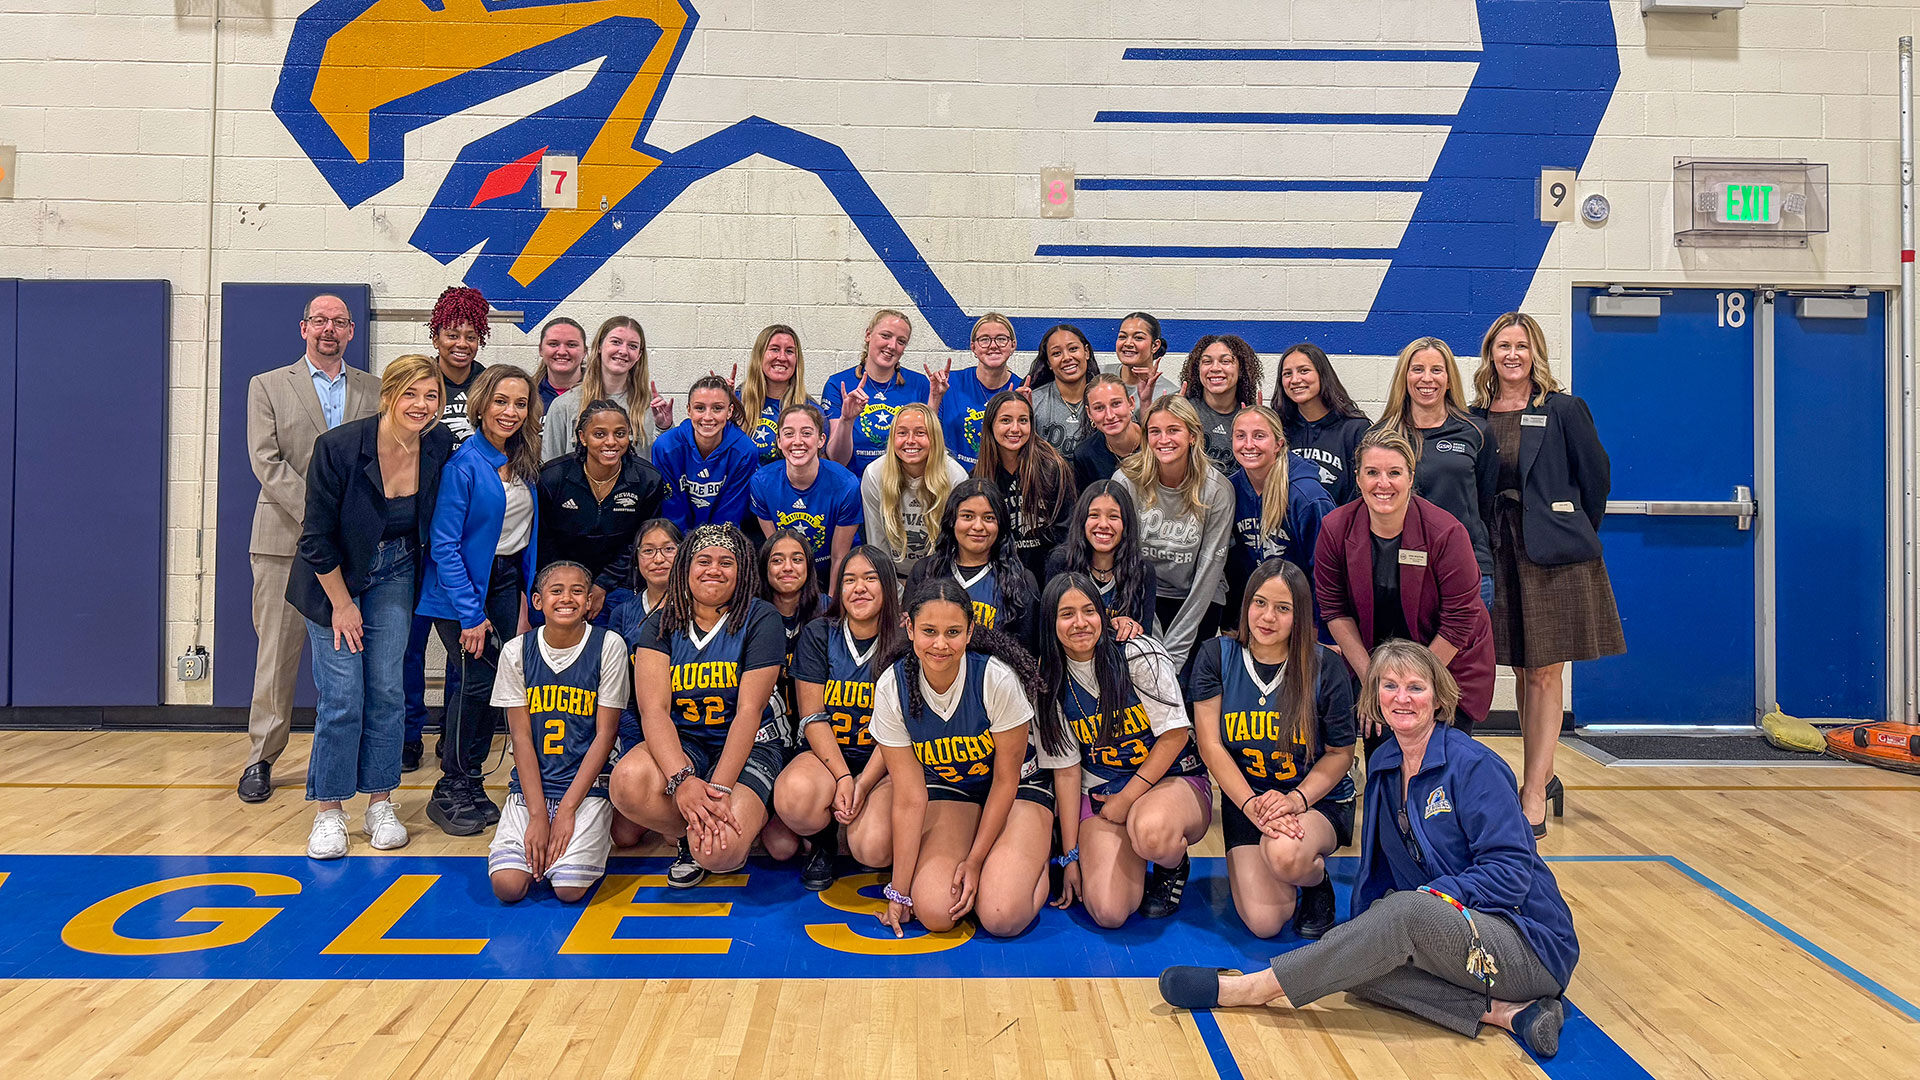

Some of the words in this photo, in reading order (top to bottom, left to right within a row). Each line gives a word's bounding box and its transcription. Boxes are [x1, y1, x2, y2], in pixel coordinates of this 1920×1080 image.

[550, 170, 568, 195] 7
[1047, 179, 1068, 206] 8
[1549, 182, 1567, 208] 9
[1726, 184, 1773, 222] EXIT
[1716, 292, 1746, 328] 18
[1291, 447, 1343, 471] EVADA
[1139, 507, 1202, 547] Pack
[1141, 546, 1193, 564] SOCCER
[669, 661, 738, 692] AUGHN
[824, 679, 875, 709] VAUG
[675, 696, 725, 725] 32
[543, 719, 566, 755] 2
[832, 711, 872, 746] 22
[1224, 710, 1308, 745] VAUG
[912, 728, 995, 766] VAUGHN
[1095, 738, 1150, 767] 23
[933, 762, 990, 783] 24
[1241, 747, 1298, 781] 33
[0, 872, 976, 955] GLES
